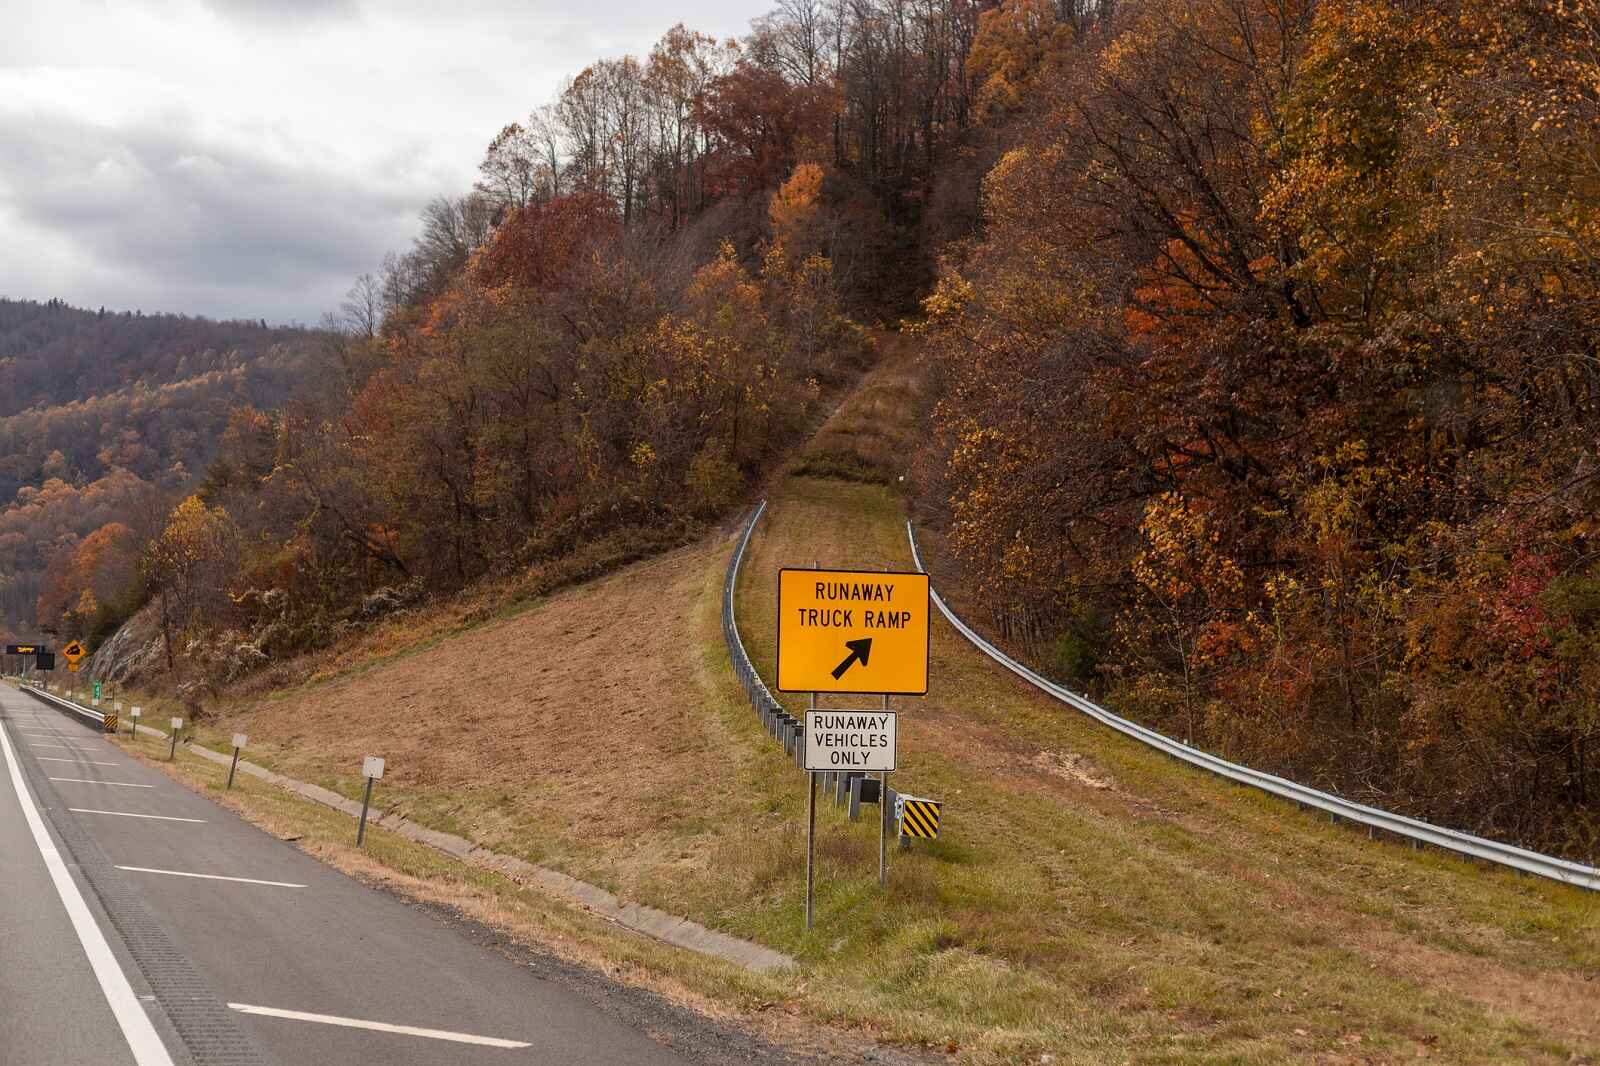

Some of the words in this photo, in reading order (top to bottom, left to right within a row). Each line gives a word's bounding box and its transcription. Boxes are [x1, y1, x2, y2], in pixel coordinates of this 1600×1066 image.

[815, 582, 894, 602] RUNAWAY
[798, 608, 853, 628] TRUCK
[864, 610, 911, 629] RAMP
[814, 715, 889, 730] RUNAWAY
[815, 733, 888, 748] VEHICLES
[830, 751, 870, 765] ONLY
